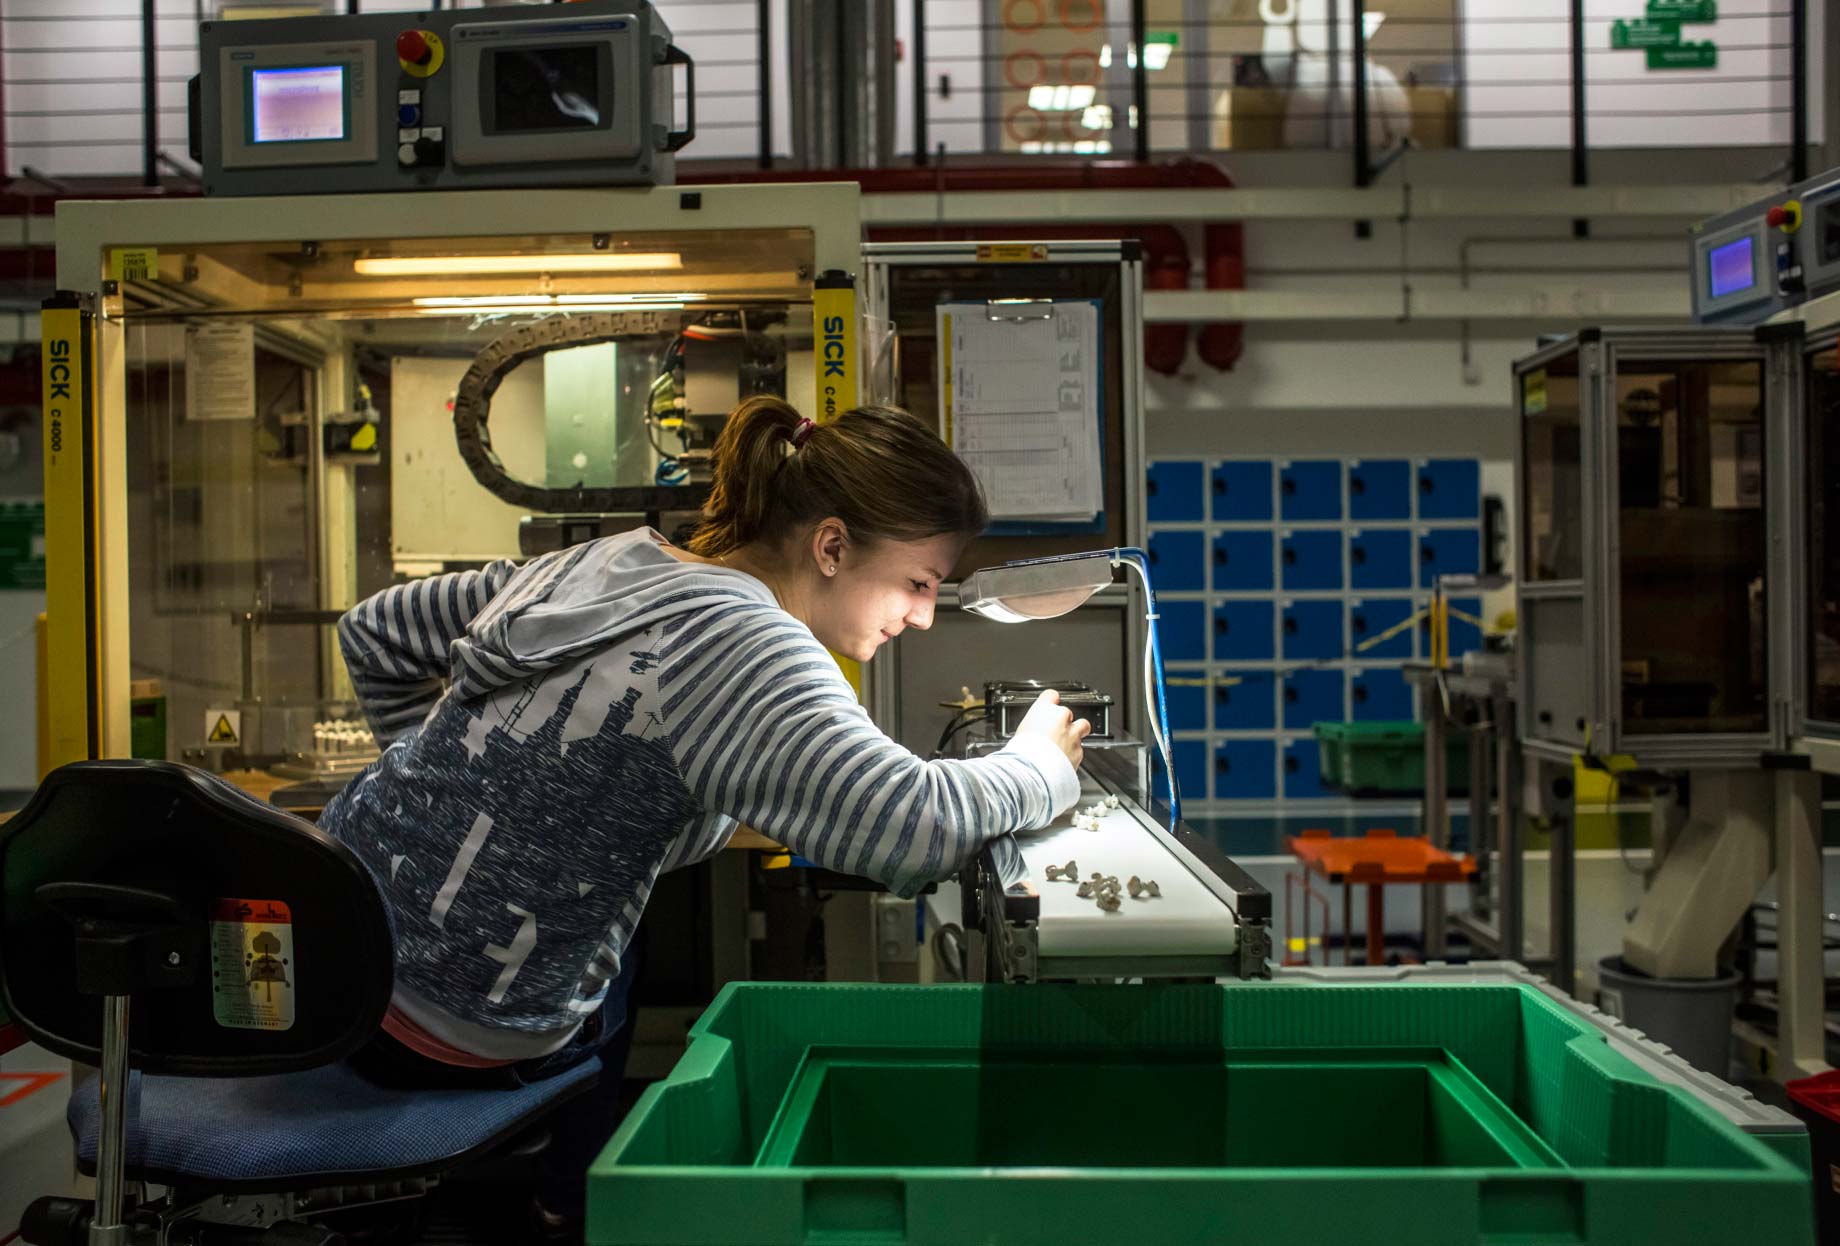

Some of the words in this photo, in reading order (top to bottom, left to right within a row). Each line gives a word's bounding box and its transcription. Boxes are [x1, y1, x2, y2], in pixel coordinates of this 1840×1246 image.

[824, 316, 845, 378] SICK
[50, 339, 70, 400] SICK
[824, 386, 836, 396] C
[50, 409, 61, 418] C
[50, 419, 62, 452] 4000
